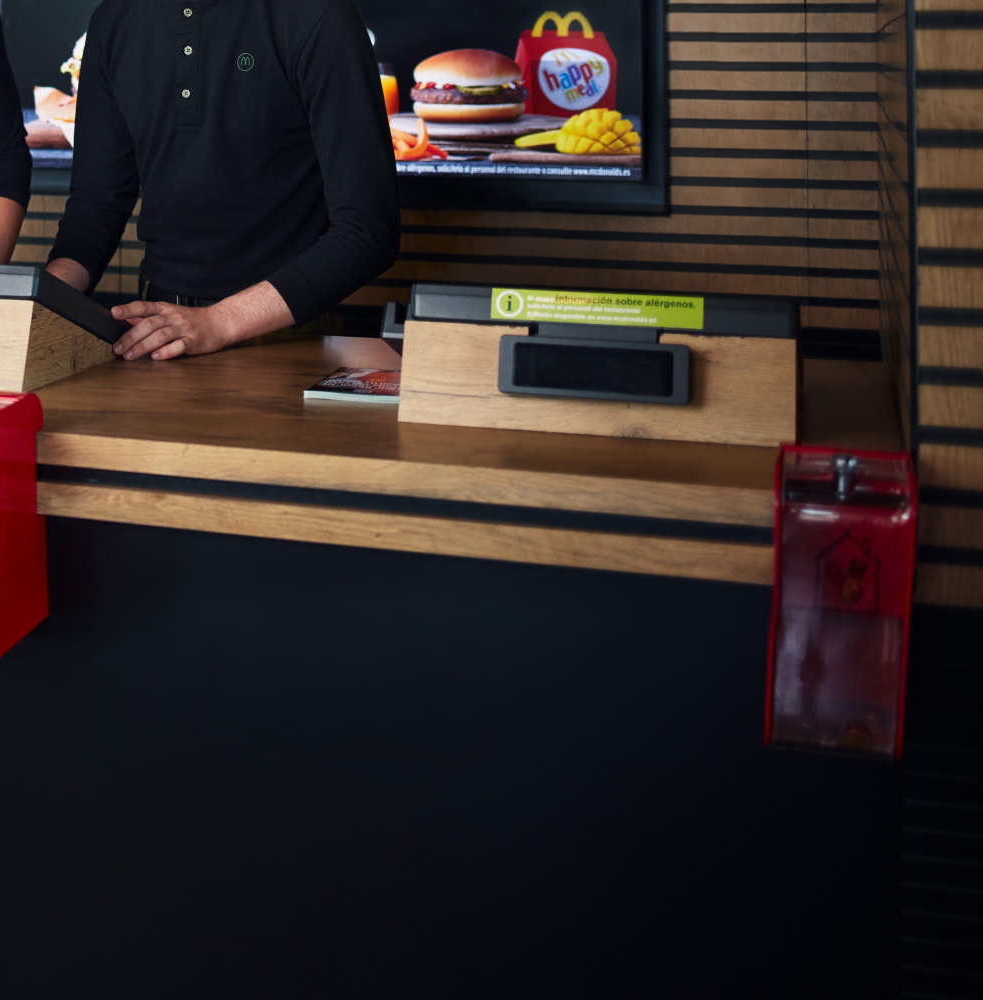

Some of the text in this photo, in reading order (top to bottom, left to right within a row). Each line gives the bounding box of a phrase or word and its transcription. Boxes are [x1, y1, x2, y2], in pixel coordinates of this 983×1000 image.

[542, 57, 604, 91] happy
[565, 79, 600, 103] meal
[555, 294, 613, 305] información
[615, 297, 643, 307] sobre
[645, 298, 696, 310] alérgenos.
